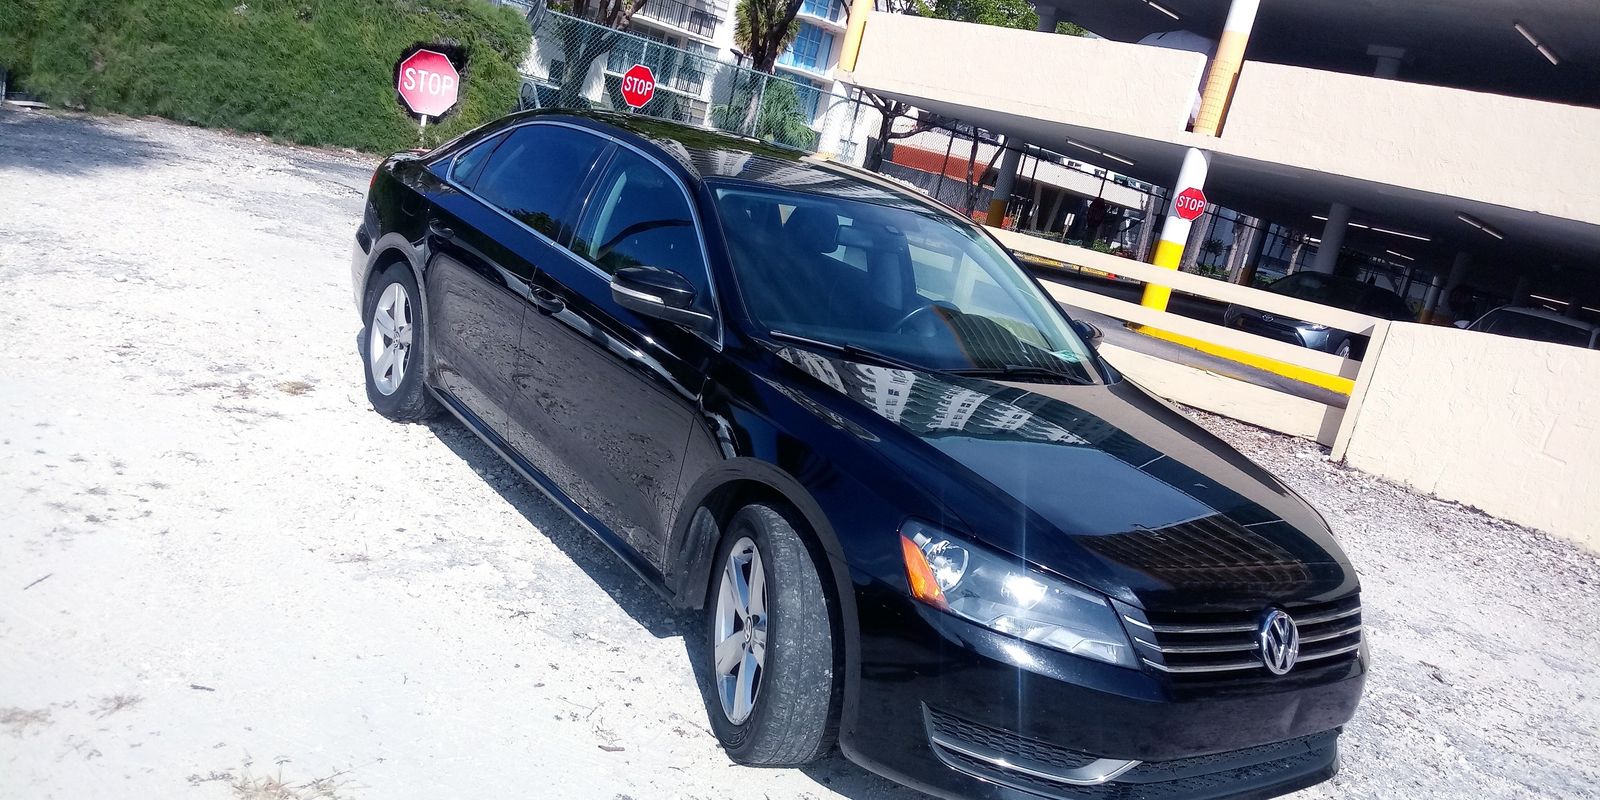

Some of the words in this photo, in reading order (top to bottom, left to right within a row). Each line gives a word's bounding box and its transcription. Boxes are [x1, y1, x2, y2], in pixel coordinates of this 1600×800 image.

[403, 67, 454, 97] STOP
[624, 76, 653, 96] STOP
[1177, 195, 1204, 212] STOP
